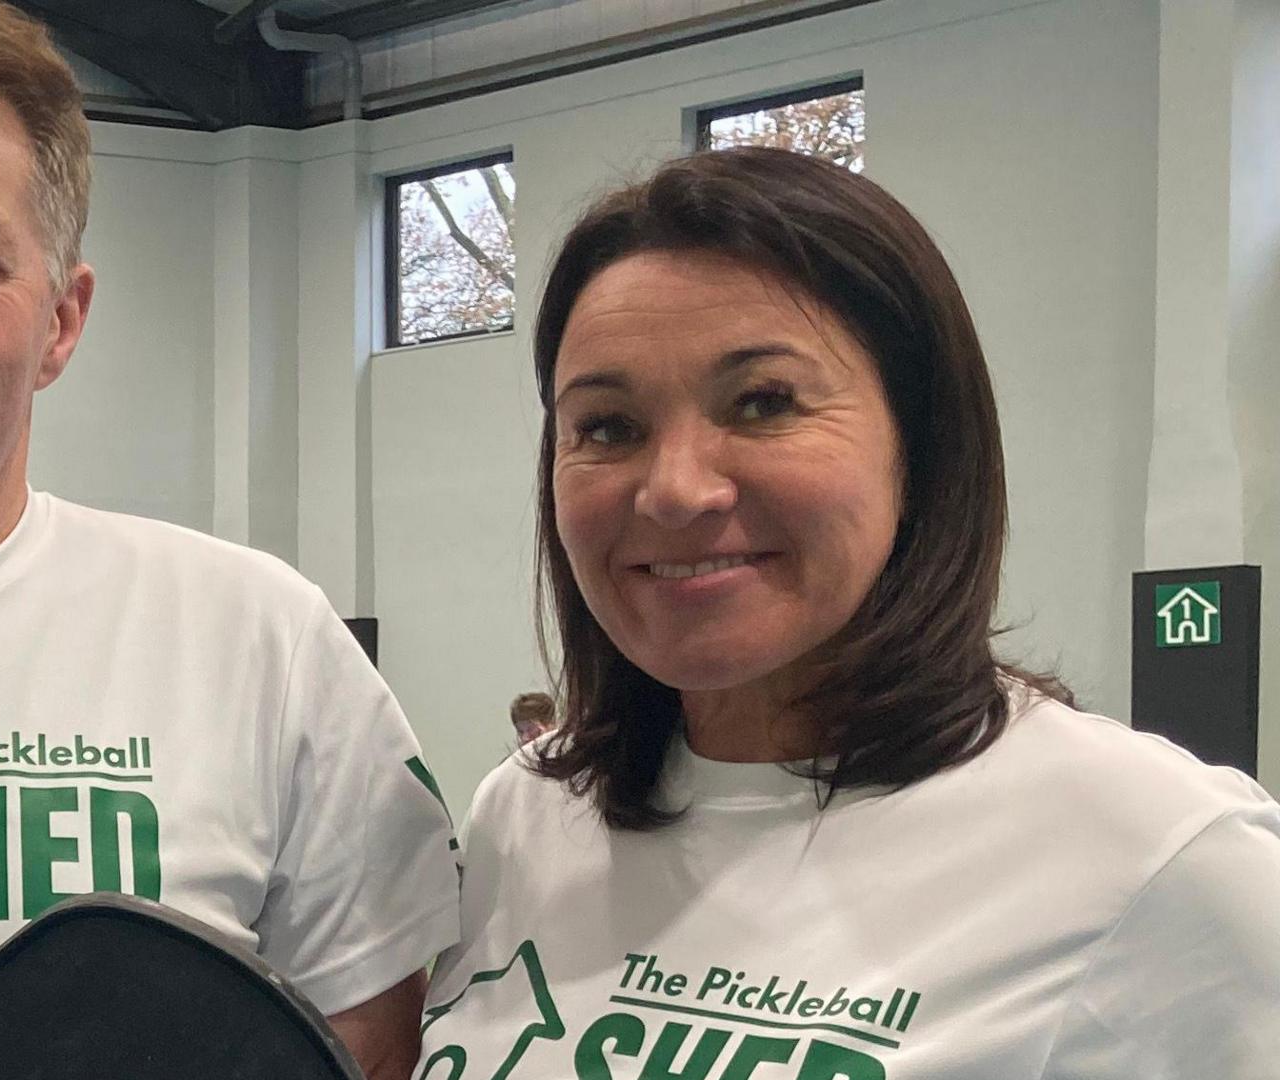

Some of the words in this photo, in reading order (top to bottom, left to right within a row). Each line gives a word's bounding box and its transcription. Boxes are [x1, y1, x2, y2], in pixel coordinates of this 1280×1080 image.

[1181, 598, 1190, 619] 1
[619, 953, 689, 997] The
[698, 965, 921, 1033] Pickleball
